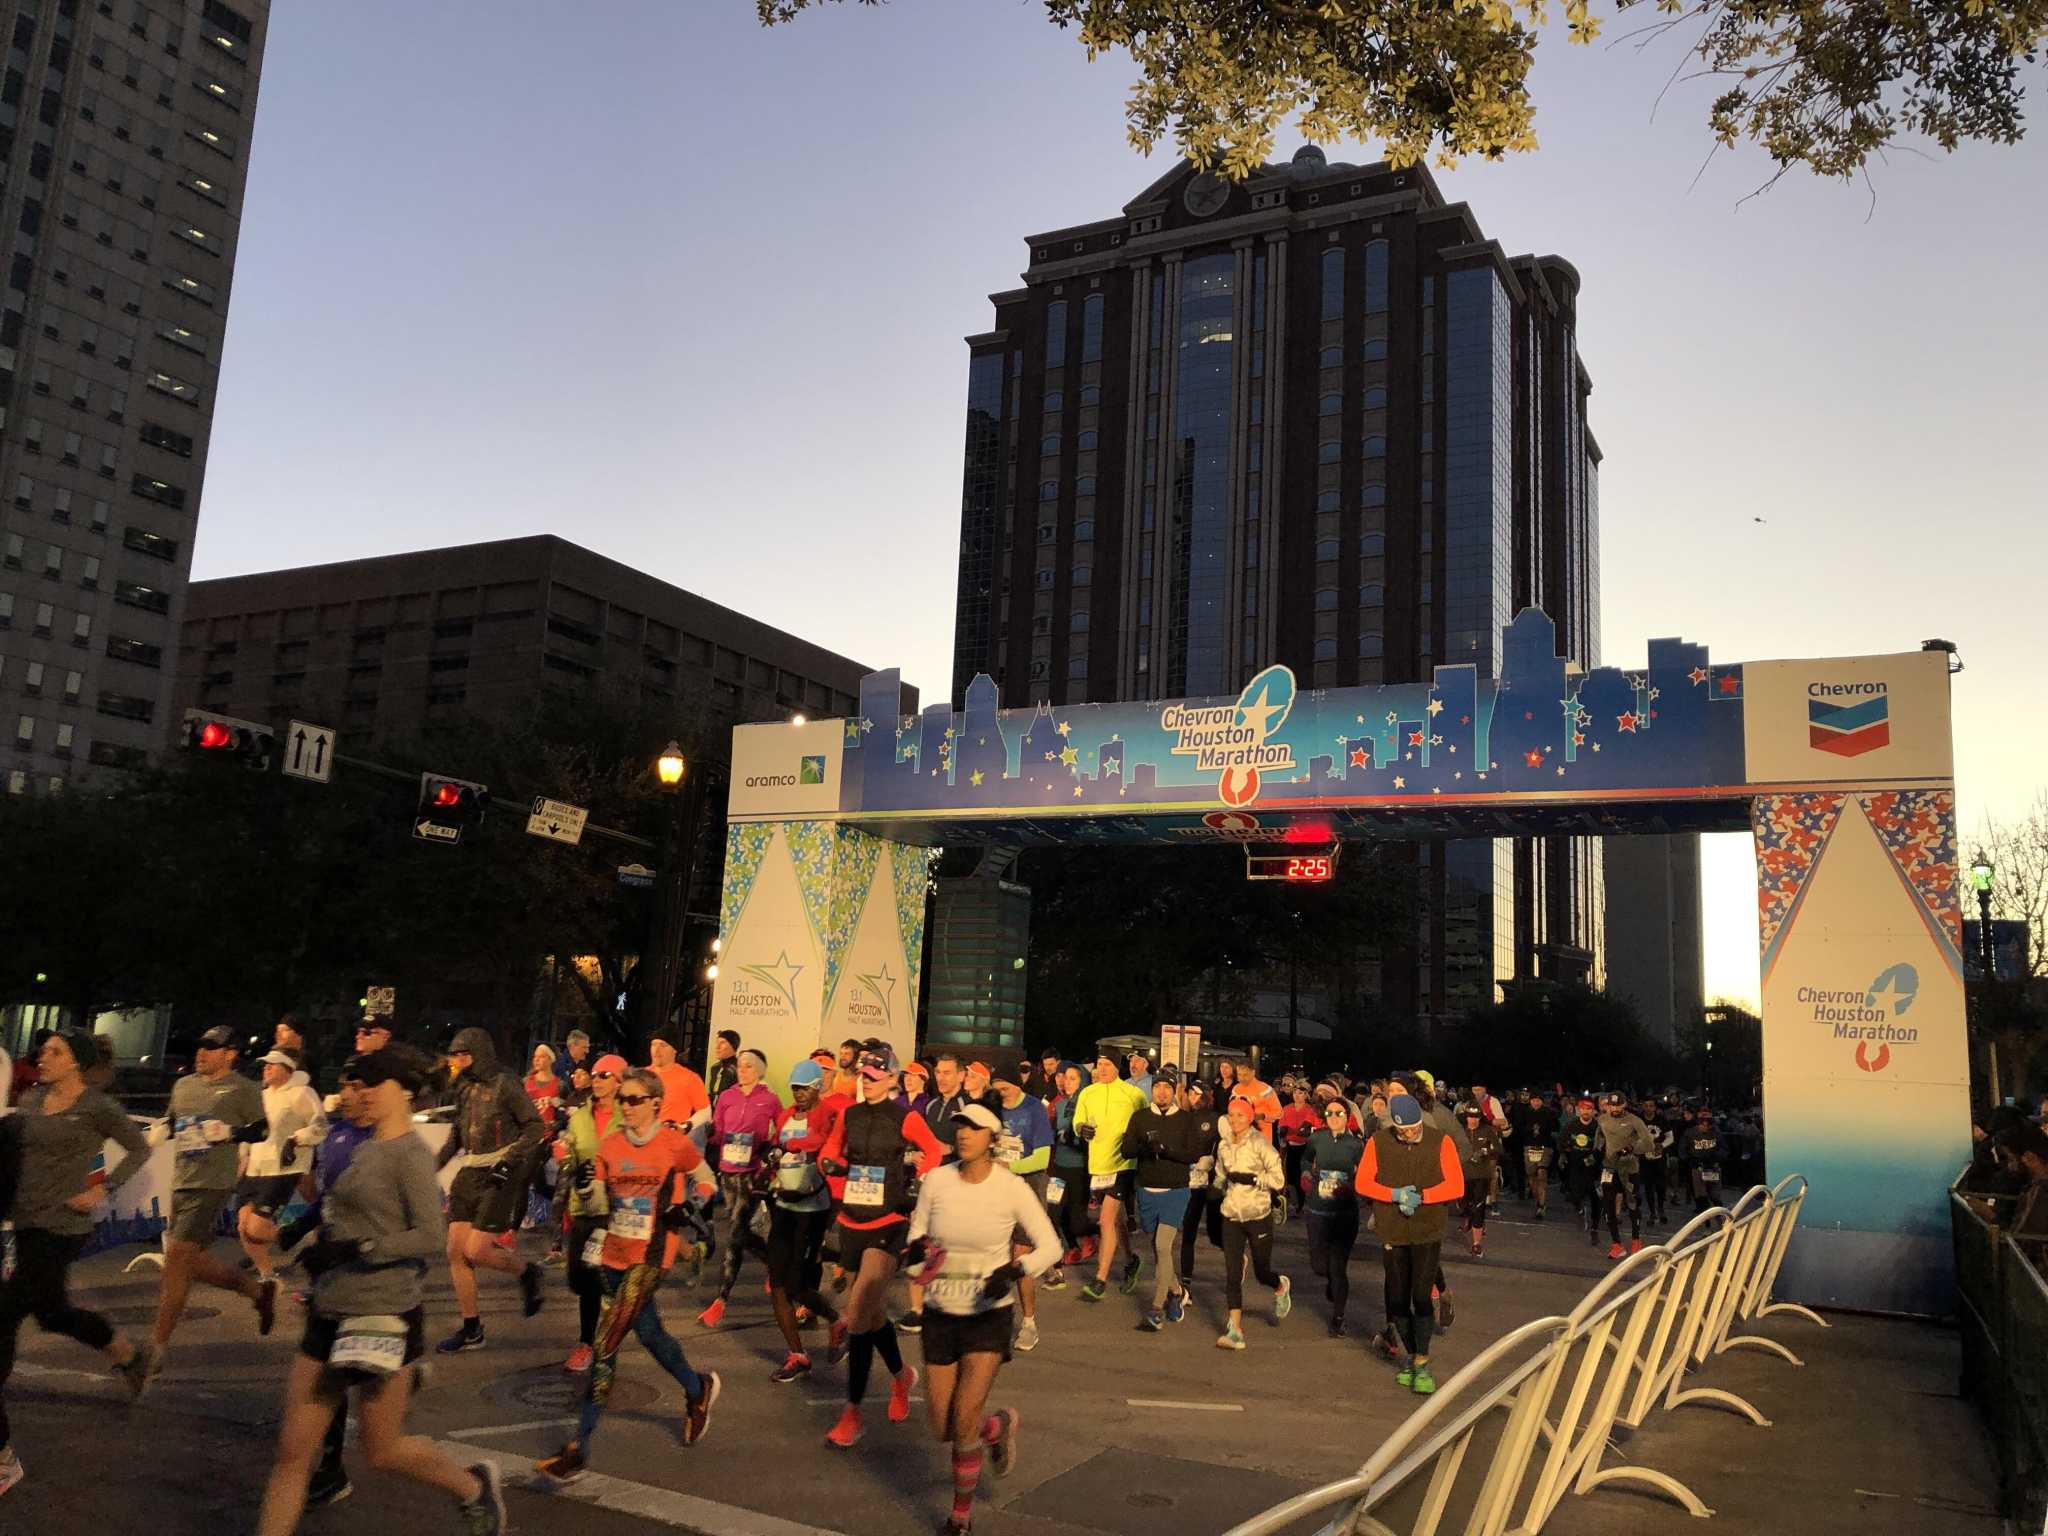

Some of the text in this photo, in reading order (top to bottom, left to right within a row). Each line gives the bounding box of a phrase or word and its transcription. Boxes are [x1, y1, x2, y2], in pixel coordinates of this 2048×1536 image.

[1808, 682, 1887, 696] Chevron
[1164, 707, 1234, 729] Chevron
[1179, 727, 1255, 748] Houston
[1200, 745, 1289, 767] Marathon
[745, 775, 796, 787] aramco
[425, 824, 456, 837] ONE WAY
[731, 995, 781, 1006] HOUSTON
[1797, 987, 1865, 1004] Chevron
[730, 1007, 790, 1017] HALF MARATHON
[849, 1002, 882, 1017] HOUSTON
[1814, 1005, 1885, 1023] Houston
[1833, 1023, 1918, 1041] Marathon
